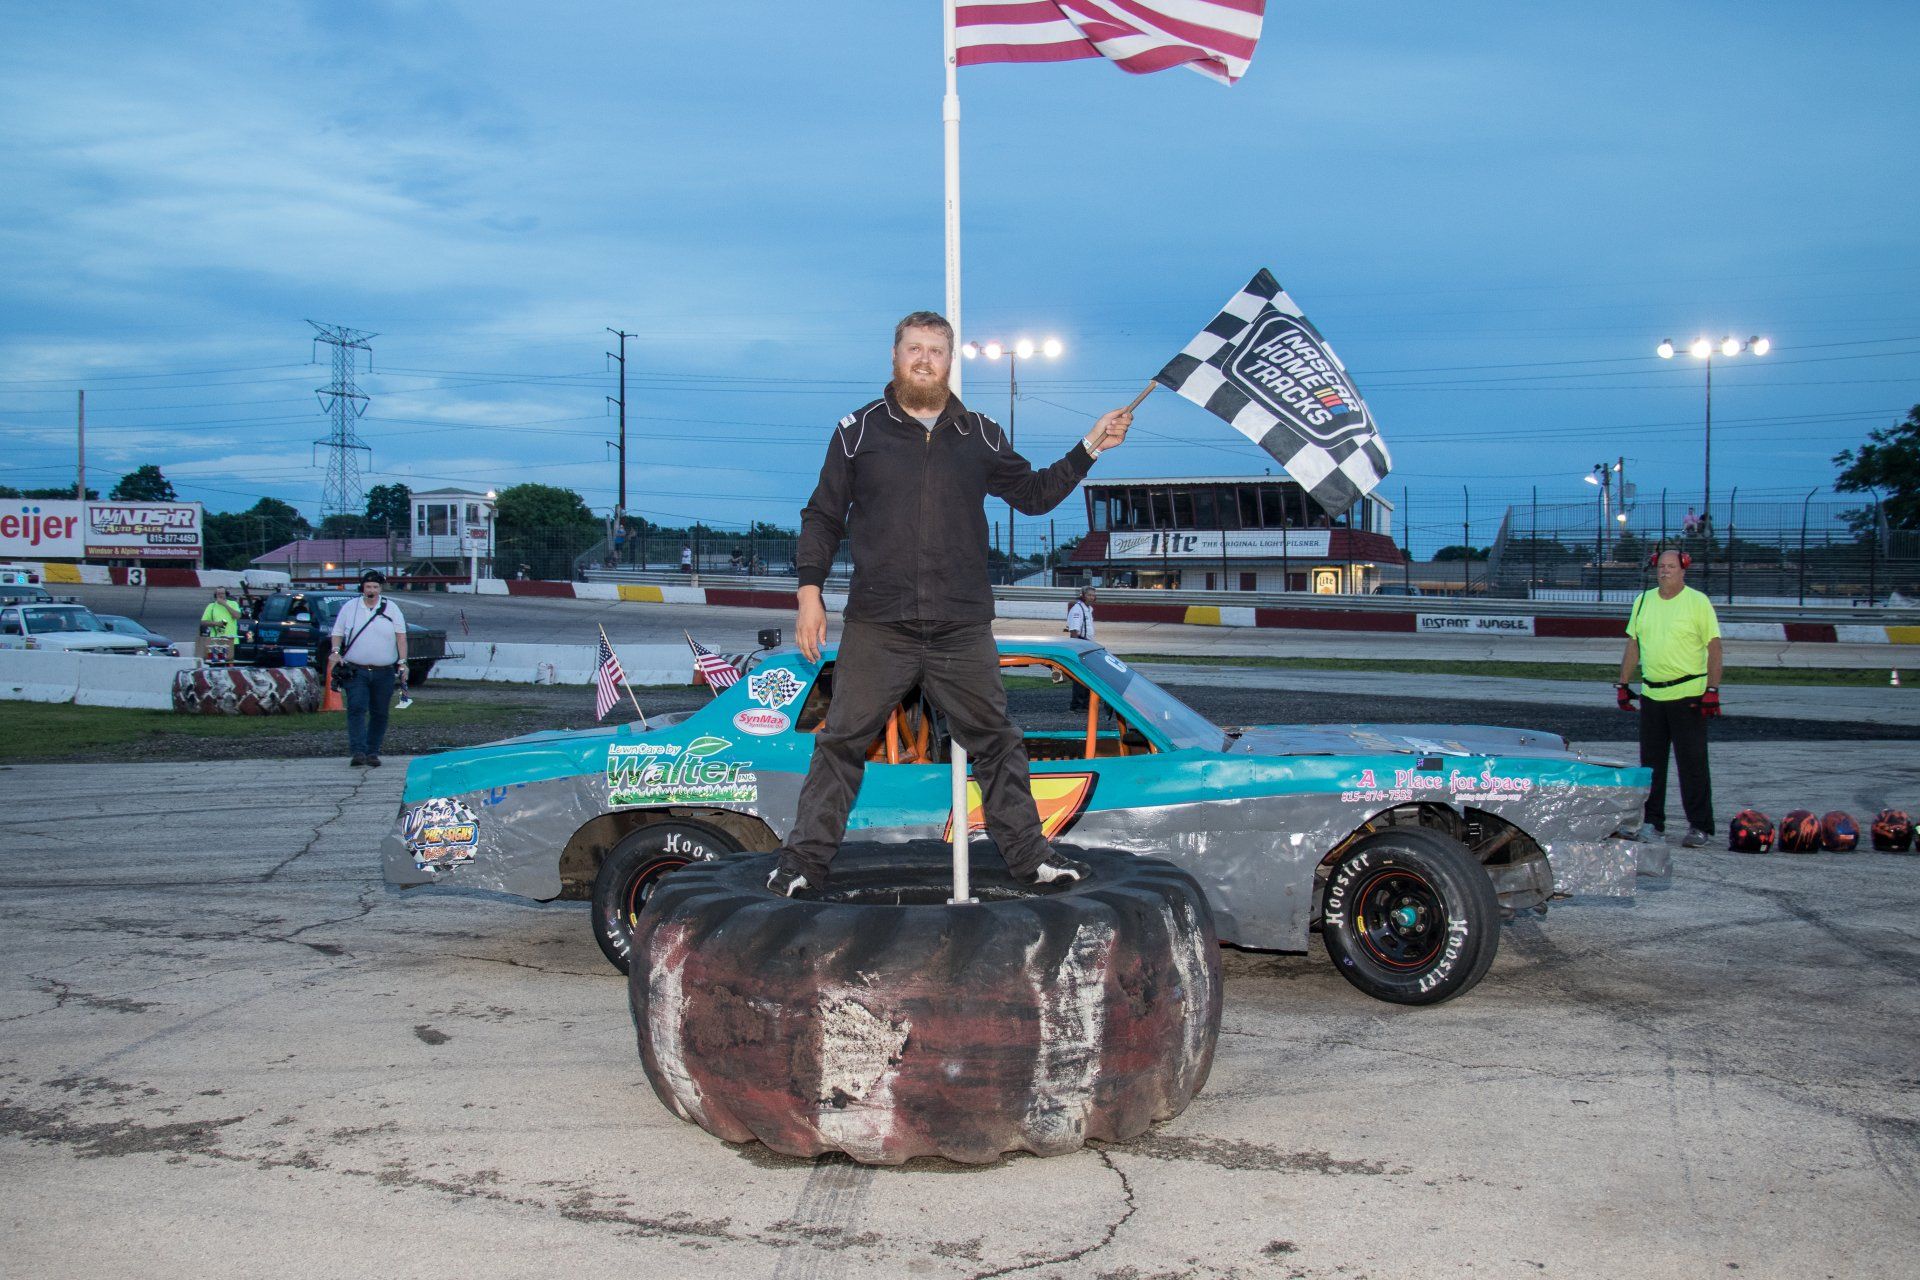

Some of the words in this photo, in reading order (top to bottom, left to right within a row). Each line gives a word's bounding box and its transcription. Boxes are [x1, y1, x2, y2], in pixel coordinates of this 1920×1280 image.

[1253, 338, 1326, 390] HOME
[1283, 334, 1360, 412] NASCAR
[1244, 359, 1333, 425] TRACKS
[0, 506, 78, 546] eijer
[1114, 535, 1151, 553] Miller
[130, 568, 142, 586] 3
[1422, 617, 1470, 629] INSTANT
[739, 713, 784, 725] SynMax
[665, 743, 681, 756] by
[607, 753, 753, 788] Walter
[1356, 769, 1377, 789] A
[1394, 768, 1443, 790] Place
[1449, 769, 1477, 794] for
[1480, 770, 1532, 795] Space
[662, 832, 715, 862] Hoos
[1325, 852, 1370, 929] Hoosier
[1418, 918, 1469, 993] Hoosier
